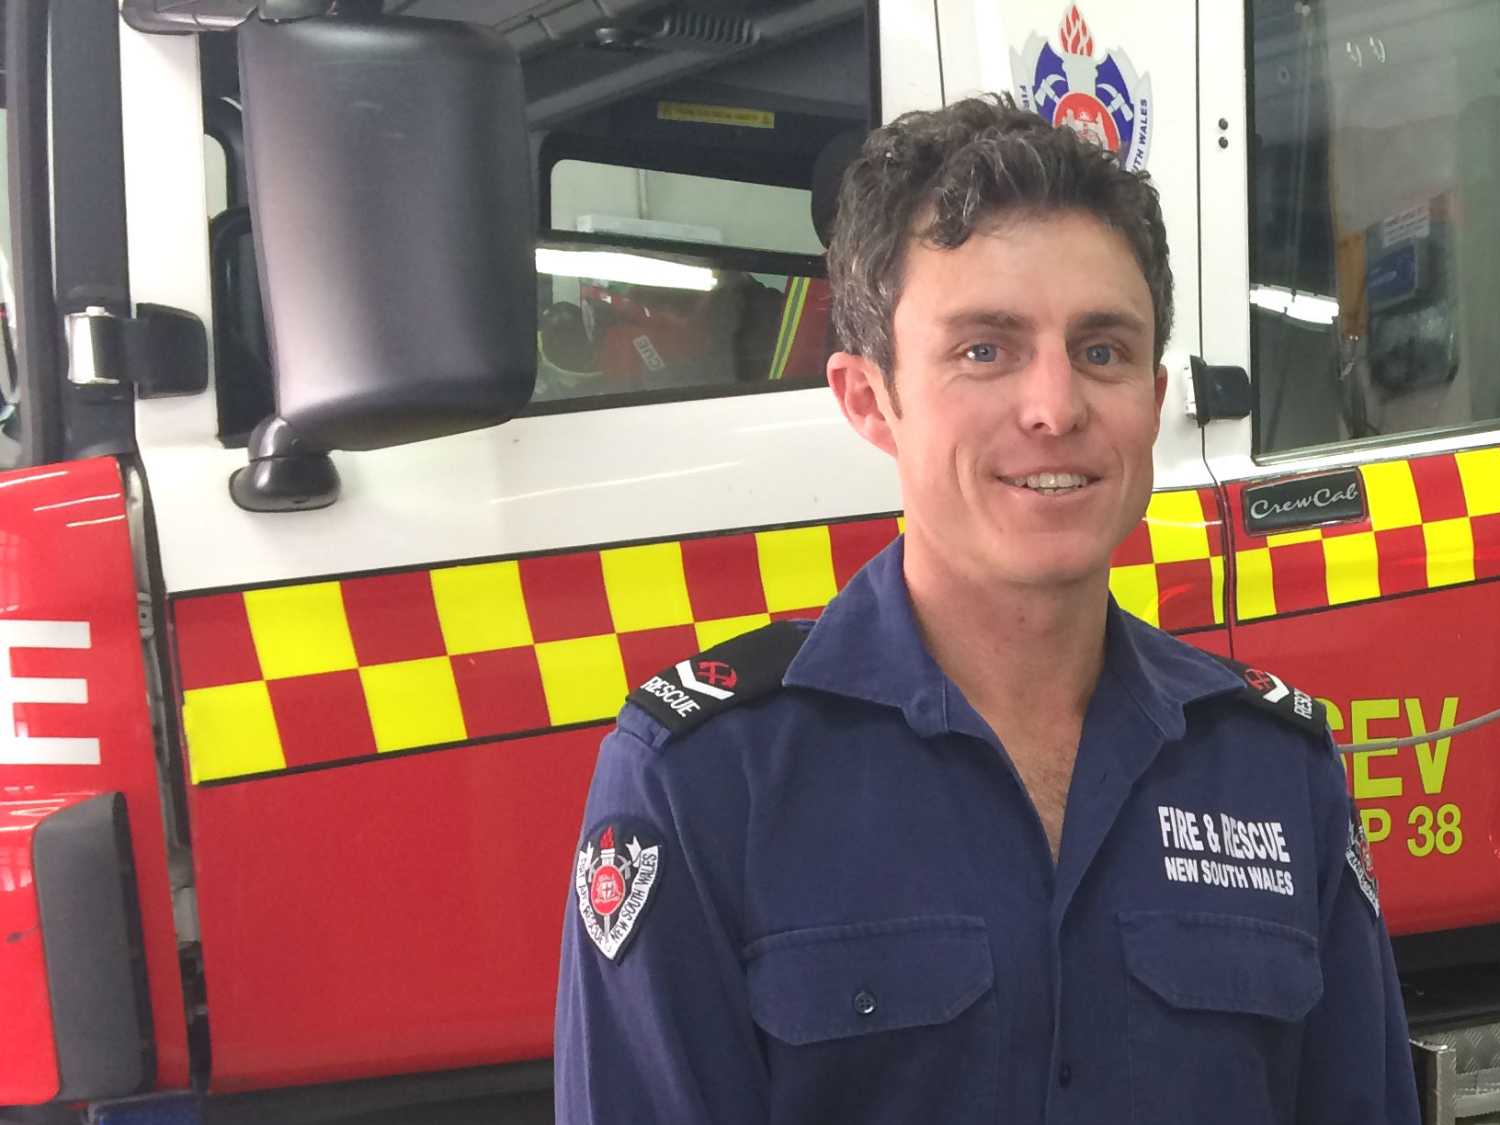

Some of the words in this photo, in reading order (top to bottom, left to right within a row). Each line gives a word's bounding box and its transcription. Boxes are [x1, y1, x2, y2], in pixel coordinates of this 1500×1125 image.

[1138, 98, 1148, 145] WALES
[640, 675, 701, 718] RESCUE
[1158, 806, 1204, 851] FIRE
[1203, 814, 1221, 853] &
[1220, 813, 1291, 863] RESCUE
[1407, 803, 1463, 857] 38
[621, 888, 645, 921] SOUTH
[634, 852, 657, 887] WALES
[1164, 856, 1199, 883] NEW
[1201, 859, 1249, 888] SOUTH
[1247, 866, 1294, 896] WALES
